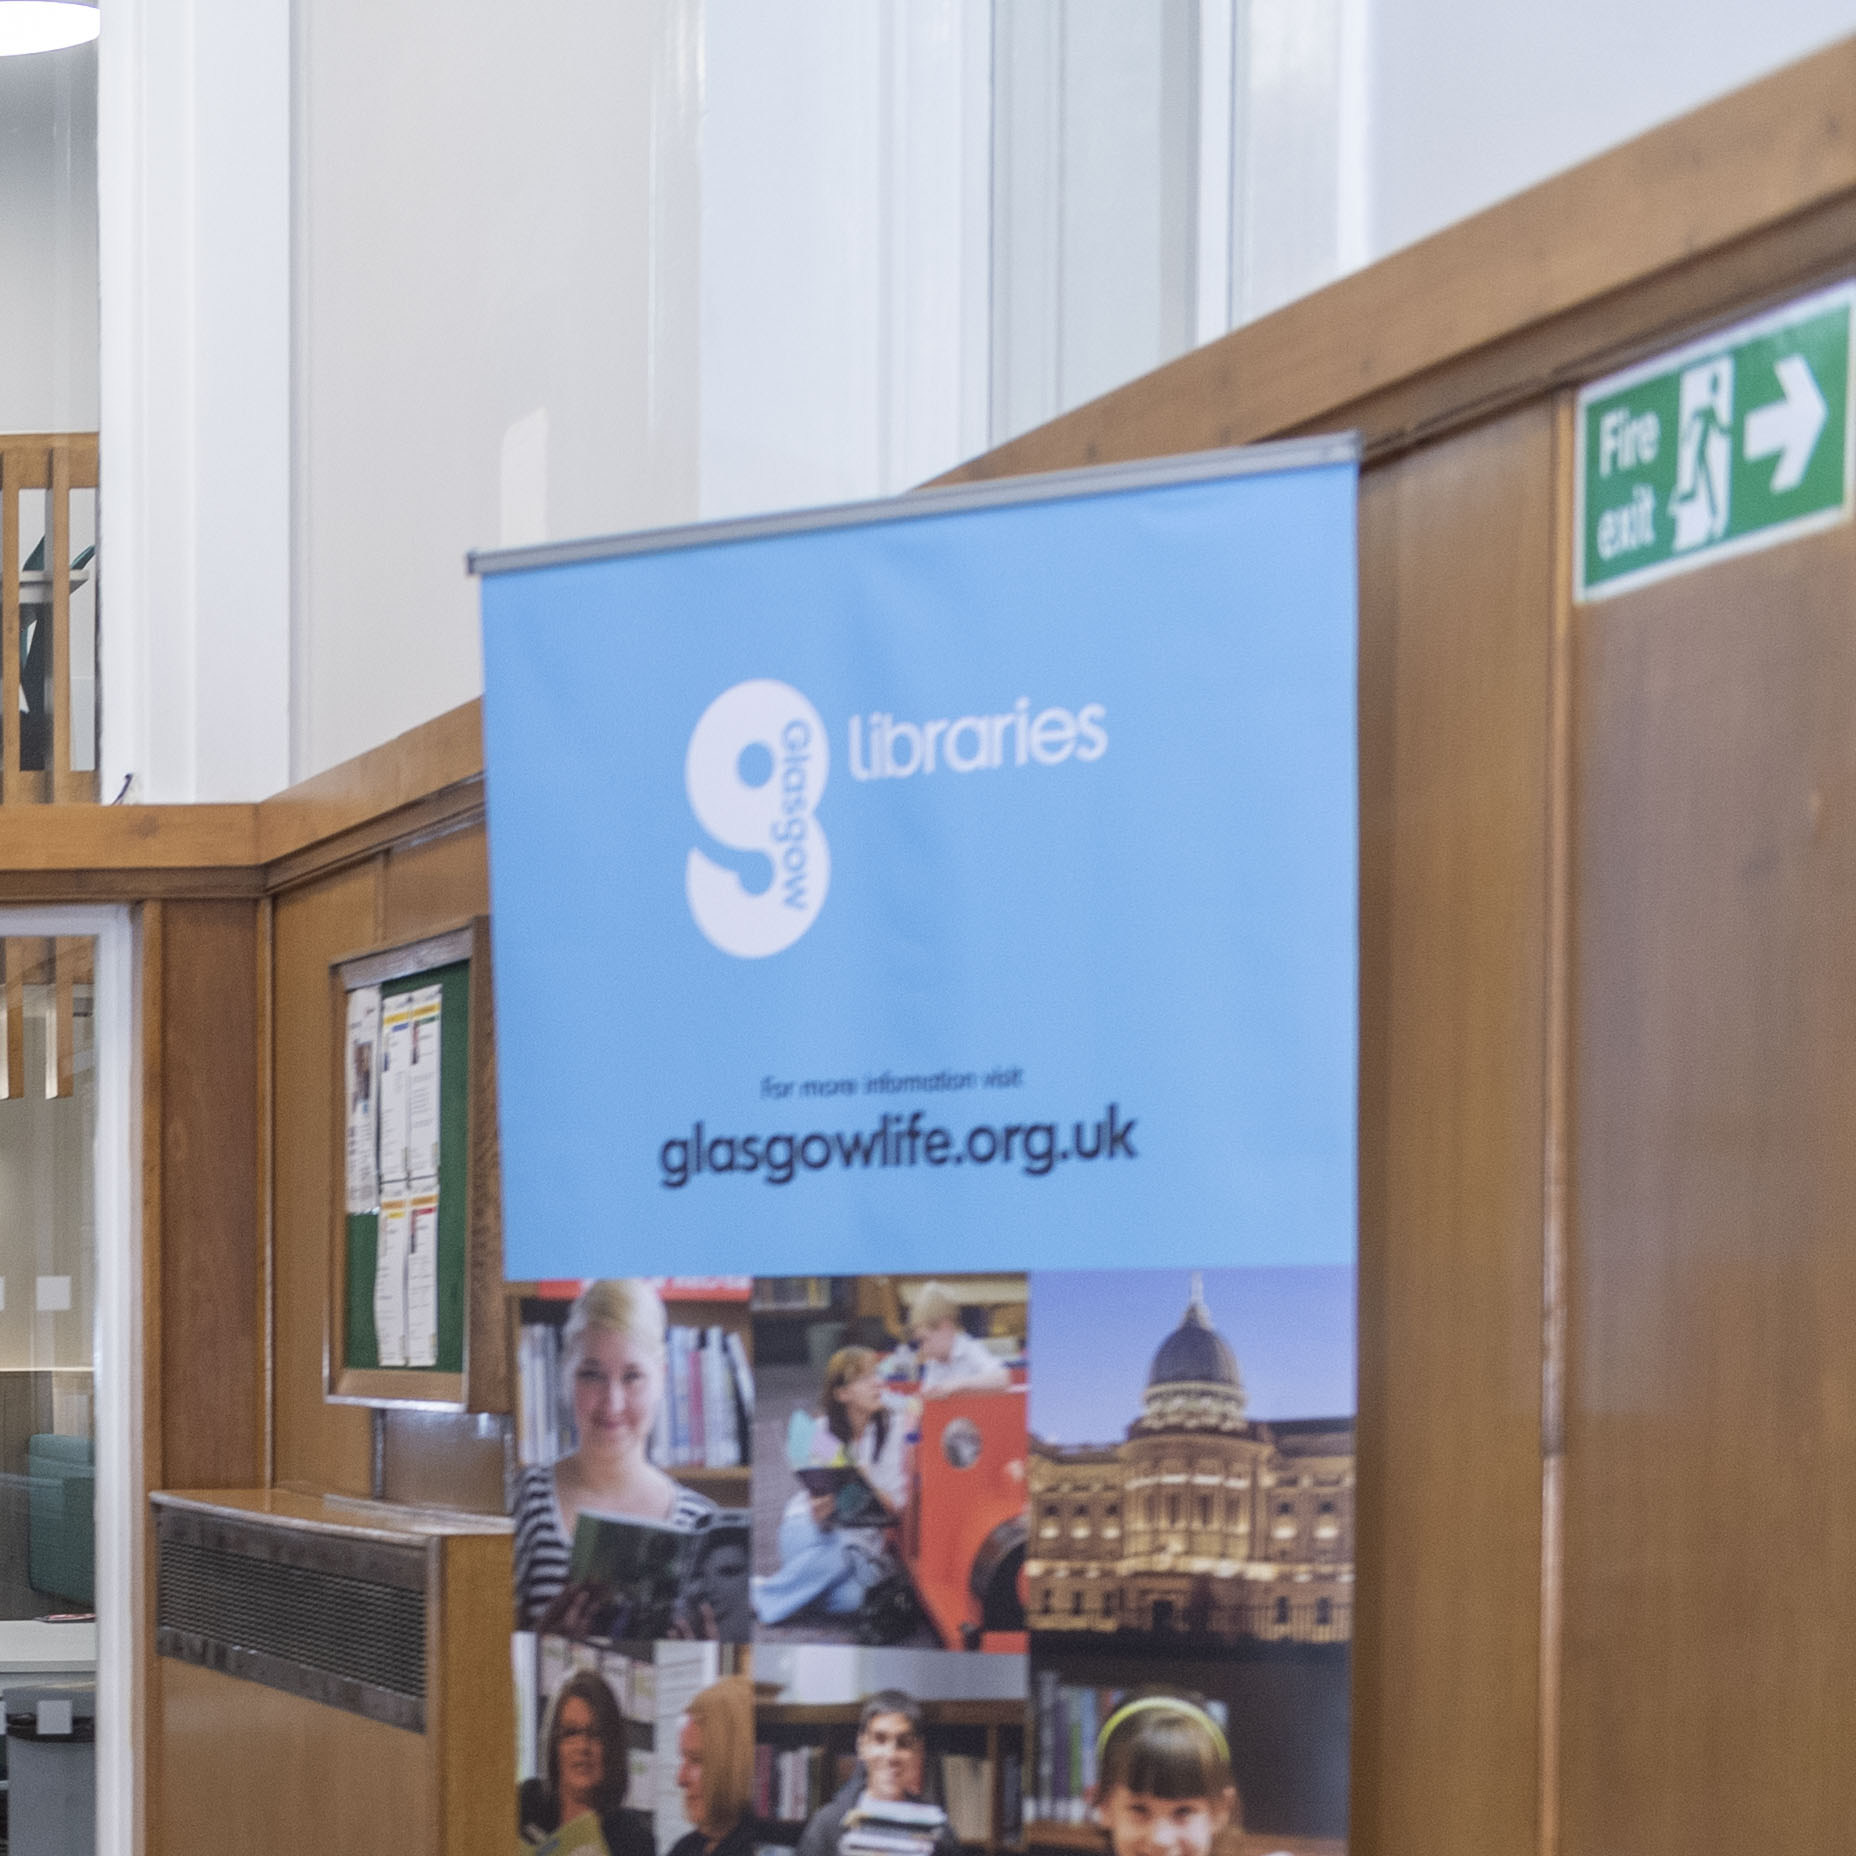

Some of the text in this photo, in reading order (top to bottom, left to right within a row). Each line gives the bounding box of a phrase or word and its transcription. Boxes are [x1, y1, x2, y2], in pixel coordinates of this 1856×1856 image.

[1598, 406, 1661, 479] Fire
[1597, 483, 1656, 561] exit
[771, 719, 813, 911] Glasgow
[760, 1075, 794, 1100] For
[863, 1068, 976, 1096] information
[659, 1101, 1139, 1188] glasgowlife.org.uk
